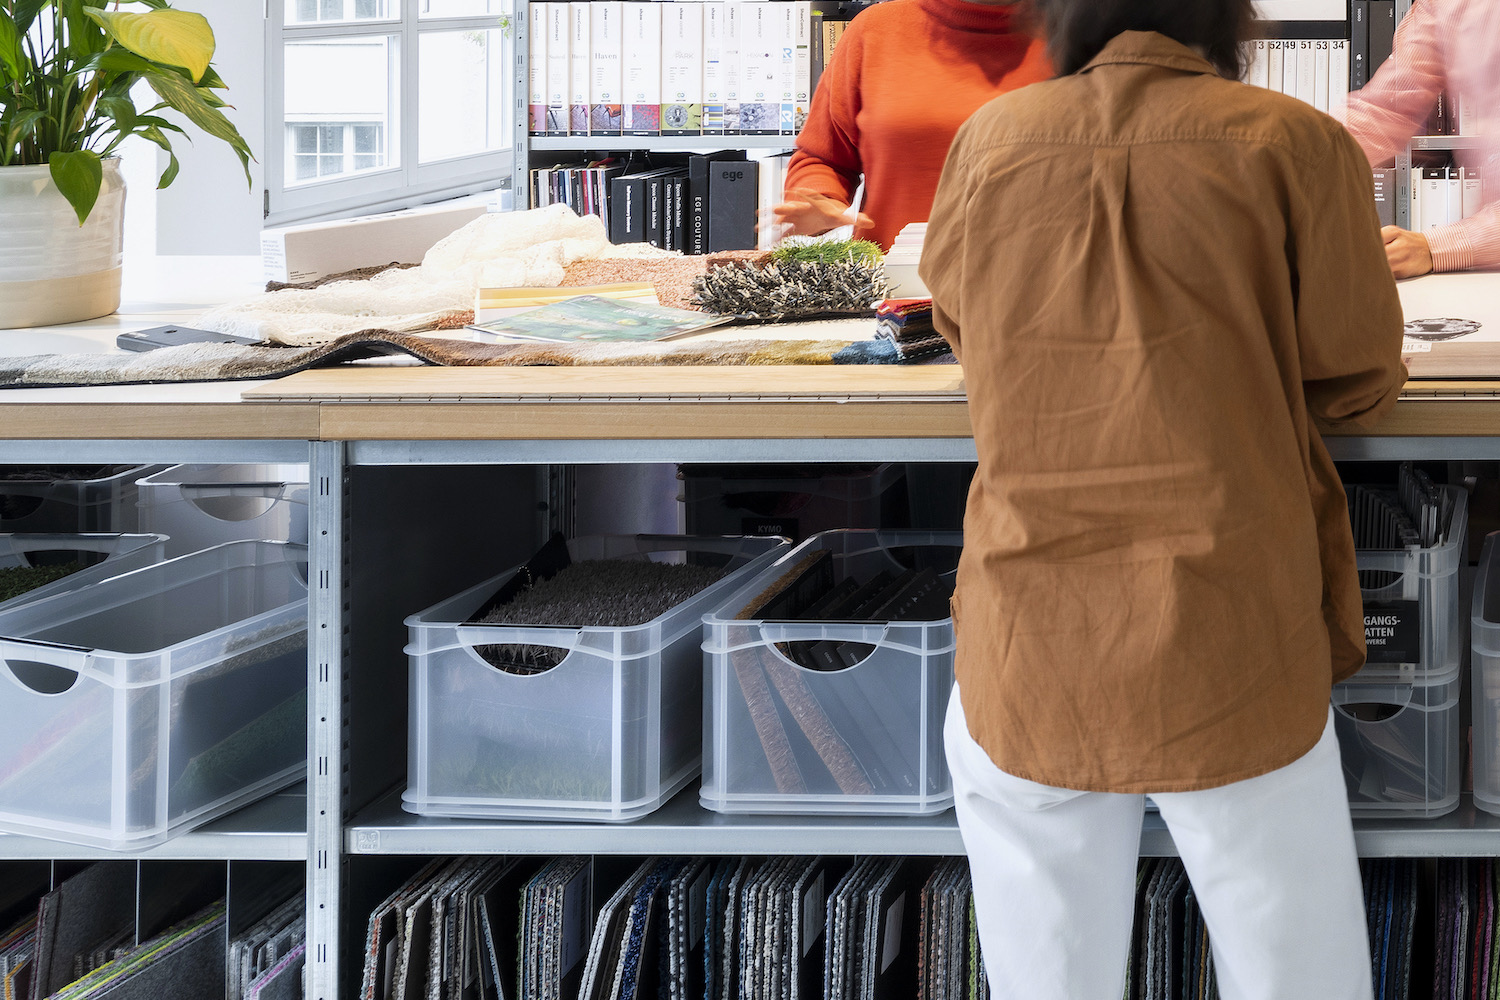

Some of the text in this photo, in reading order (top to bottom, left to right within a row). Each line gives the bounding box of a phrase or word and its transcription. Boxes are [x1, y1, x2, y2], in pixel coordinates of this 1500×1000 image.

[1269, 41, 1282, 50] 52
[1284, 41, 1296, 50] 49
[1300, 41, 1312, 50] 51
[1316, 41, 1328, 50] 53
[1332, 41, 1345, 50] 34
[594, 52, 618, 60] Haven
[722, 170, 744, 182] ege
[694, 196, 702, 254] EGE COUTURE
[757, 524, 782, 534] KYMO
[1363, 615, 1401, 626] GANGS-
[1364, 627, 1394, 637] ATTEN
